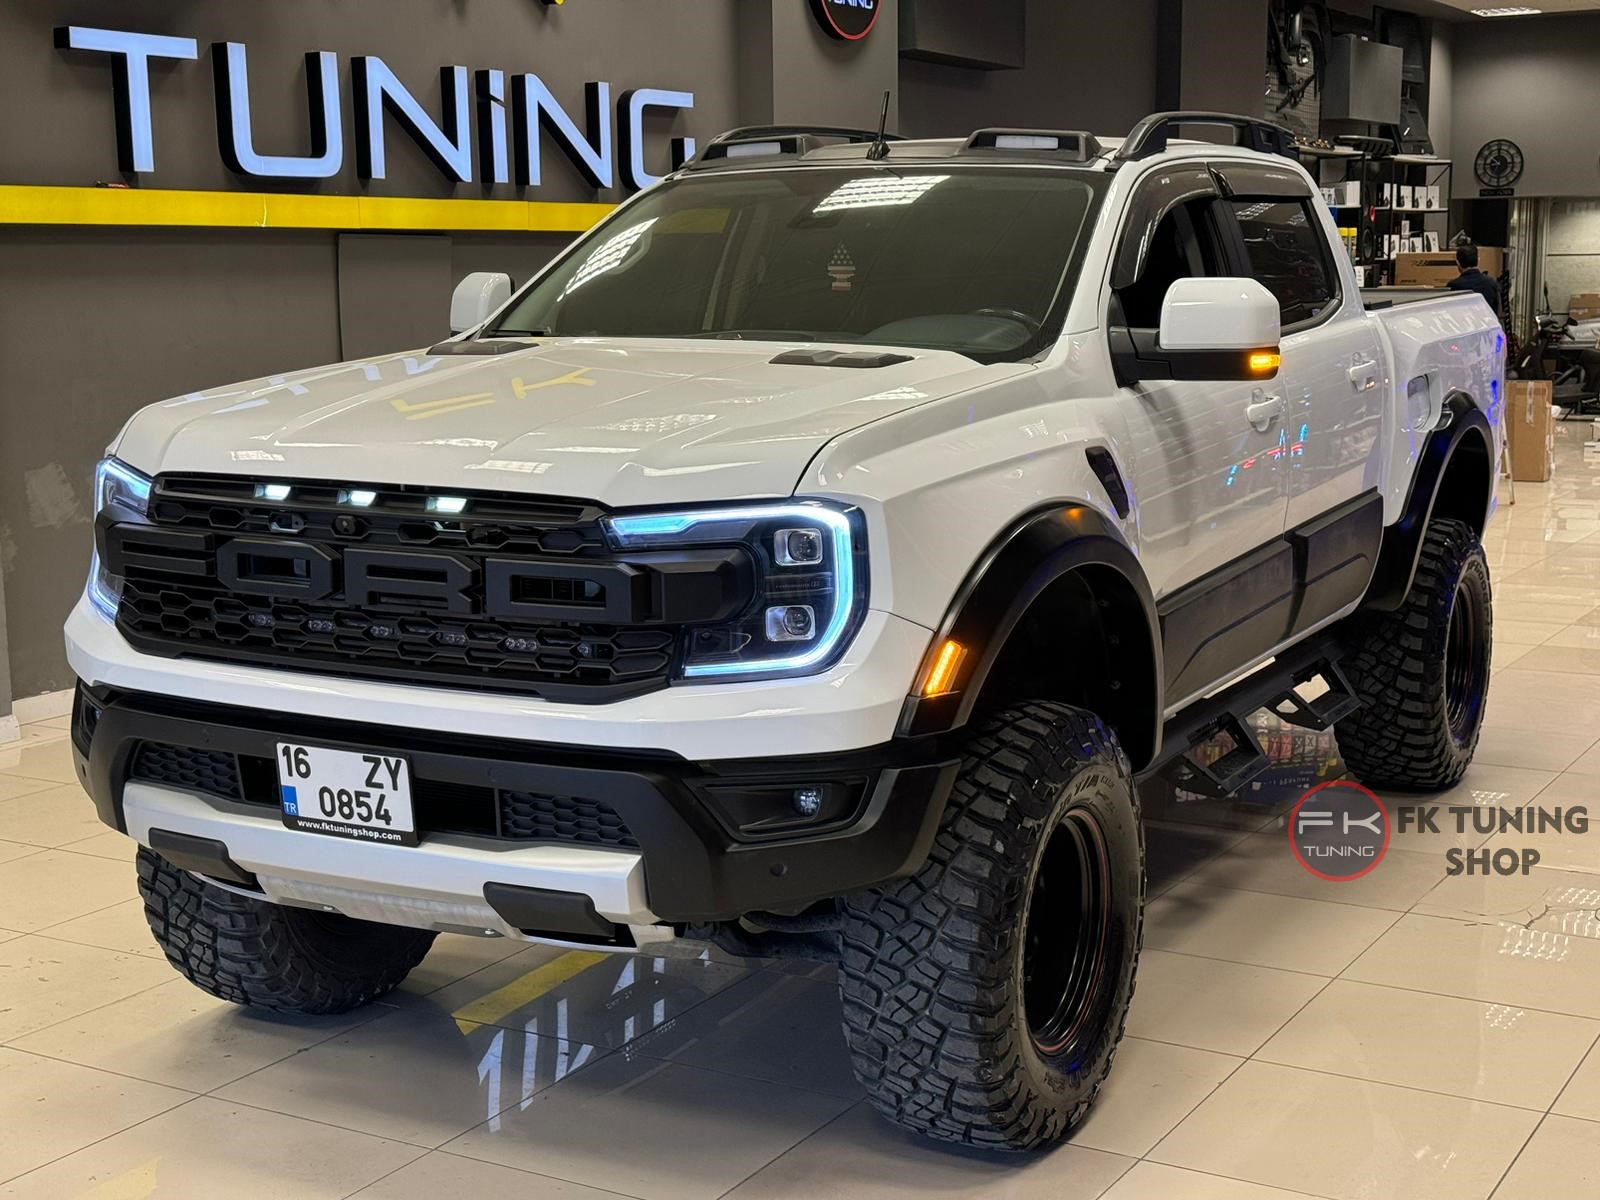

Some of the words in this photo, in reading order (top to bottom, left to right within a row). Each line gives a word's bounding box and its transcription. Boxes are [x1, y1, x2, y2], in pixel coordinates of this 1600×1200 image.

[282, 745, 312, 779] 16
[362, 754, 402, 791] ZY
[284, 801, 297, 814] TR
[319, 786, 392, 826] 0854
[297, 819, 402, 841] www.fktuningshop.com
